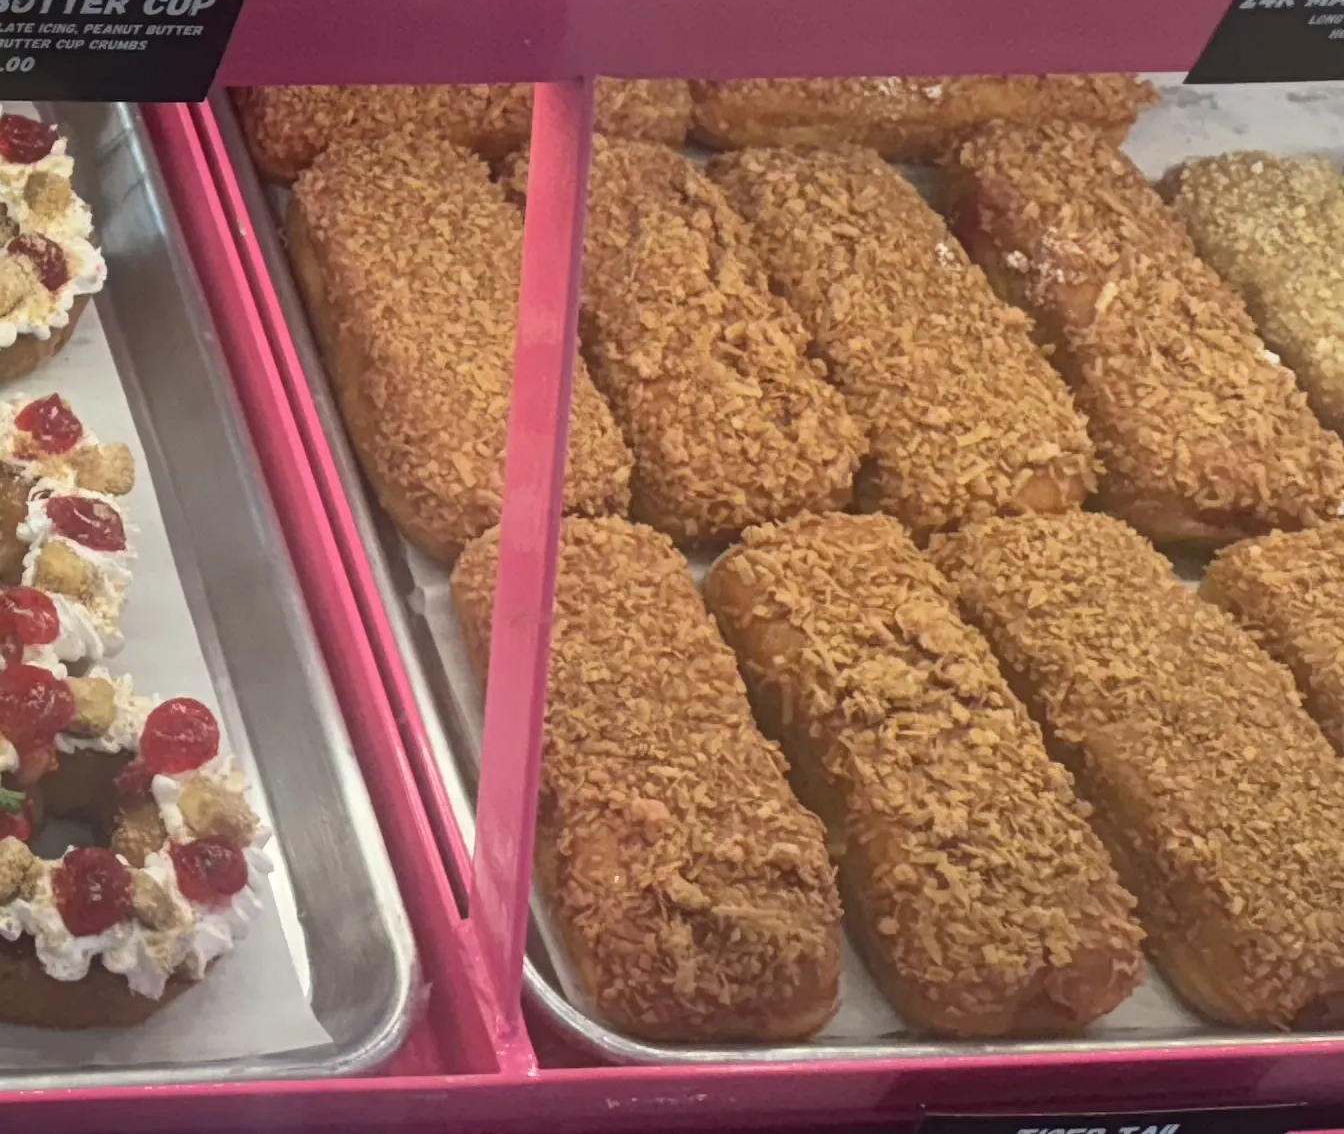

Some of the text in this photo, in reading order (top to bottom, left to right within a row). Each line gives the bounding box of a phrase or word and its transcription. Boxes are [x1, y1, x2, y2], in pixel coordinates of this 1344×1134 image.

[38, 22, 79, 35] ICING,
[83, 23, 144, 35] PEANUT
[145, 24, 205, 36] BUTTER
[55, 38, 85, 50] CUP
[88, 39, 149, 51] CRUMBS
